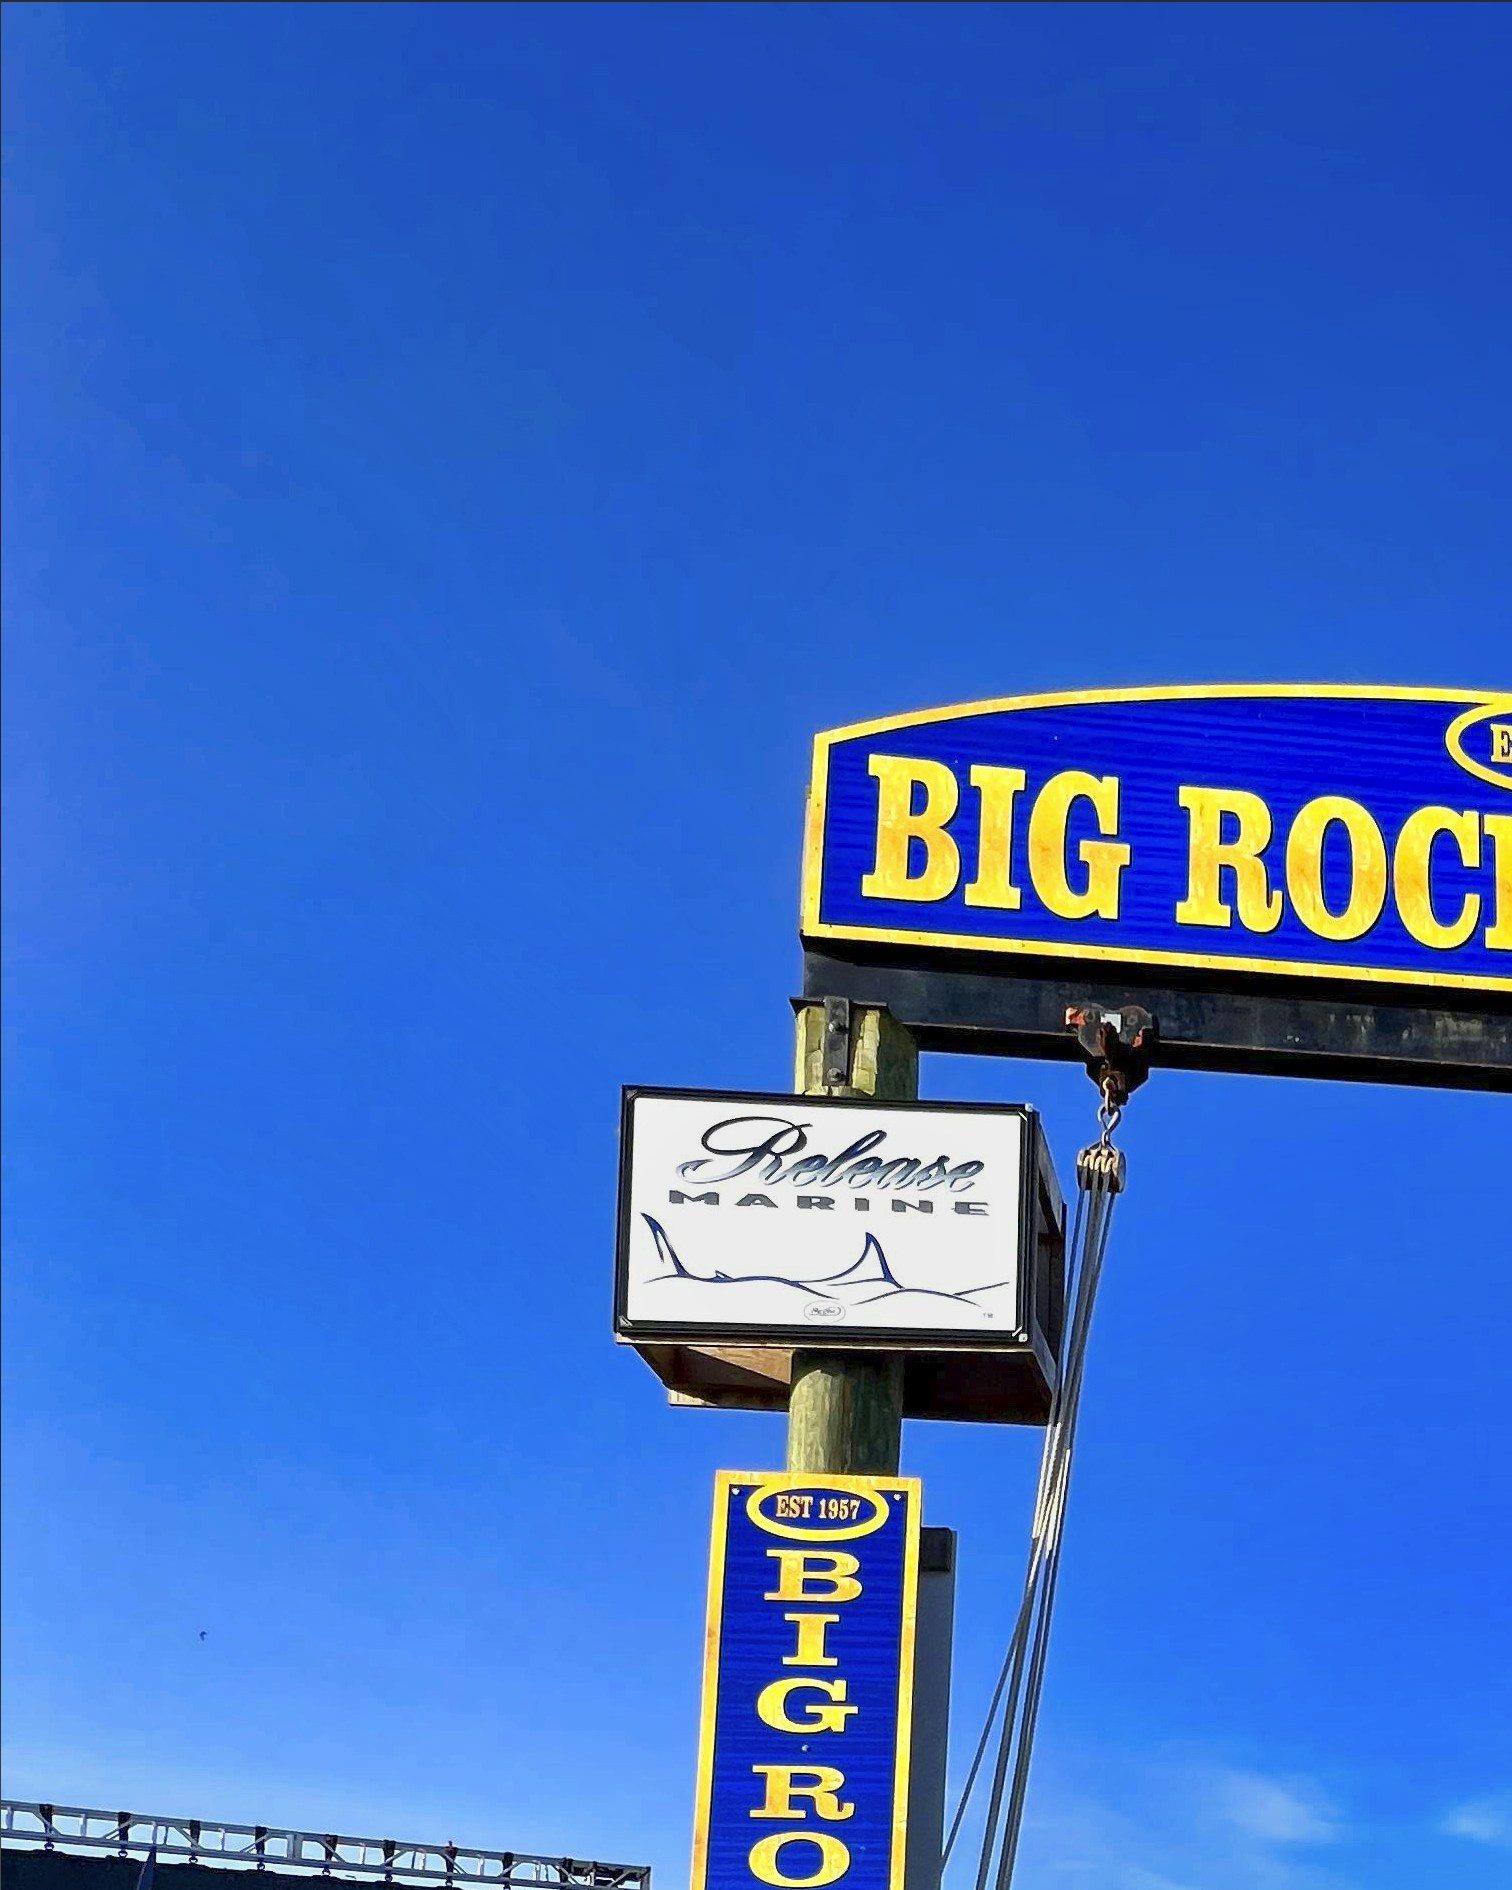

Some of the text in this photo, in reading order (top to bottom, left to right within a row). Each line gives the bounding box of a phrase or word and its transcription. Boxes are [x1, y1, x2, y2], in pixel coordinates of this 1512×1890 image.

[861, 753, 1131, 921] BIG
[676, 1116, 986, 1193] Release
[669, 1189, 990, 1217] MARINE
[775, 1496, 860, 1520] EST 1957
[756, 1548, 863, 1734] BIG
